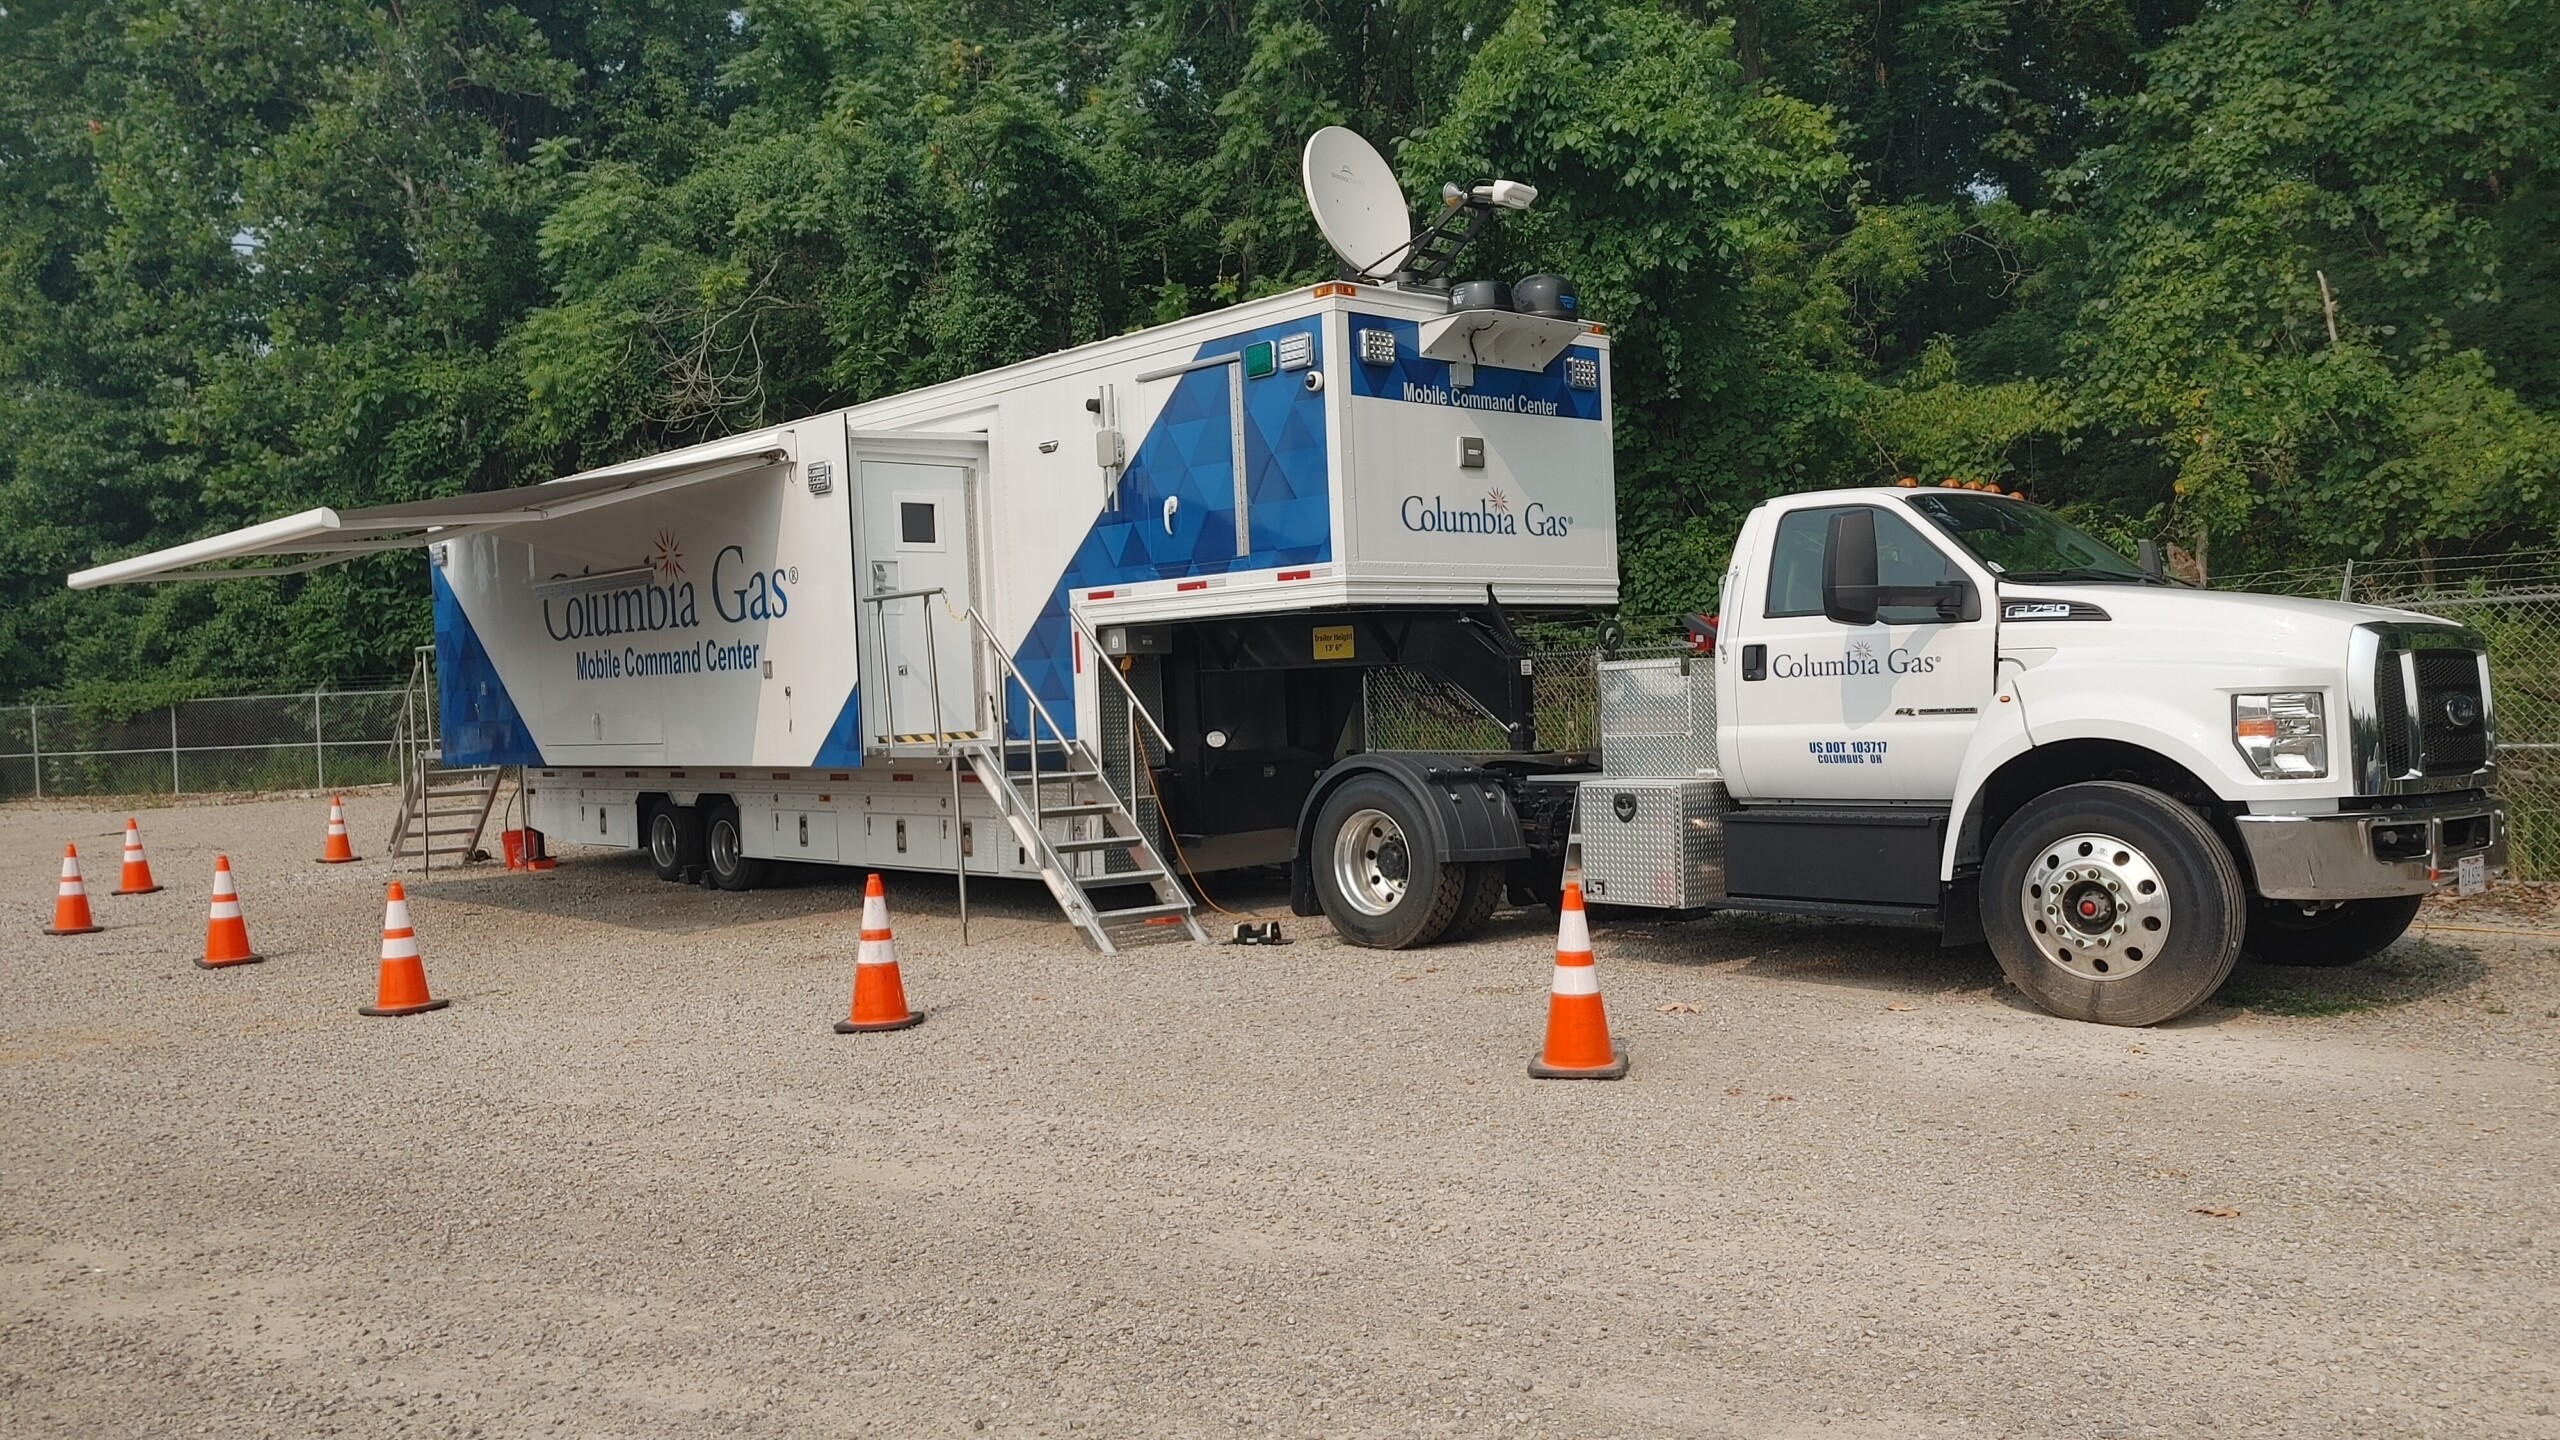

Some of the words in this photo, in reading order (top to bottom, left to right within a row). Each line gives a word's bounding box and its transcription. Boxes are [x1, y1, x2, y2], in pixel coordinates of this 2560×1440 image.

[1403, 382, 1447, 405] Mobile
[1451, 388, 1515, 412] Command
[1518, 395, 1558, 416] Center
[1401, 495, 1517, 535] Columbia
[1333, 633, 1352, 642] Height
[576, 649, 621, 681] Mobile
[624, 641, 701, 677] Command
[706, 639, 759, 671] Center
[1773, 652, 1880, 678] Columbia
[1809, 742, 1824, 753] US
[1826, 742, 1846, 753] DOT
[1851, 741, 1887, 753] 103717
[1818, 754, 1864, 764] COLUMBUS
[1870, 754, 1883, 764] OH
